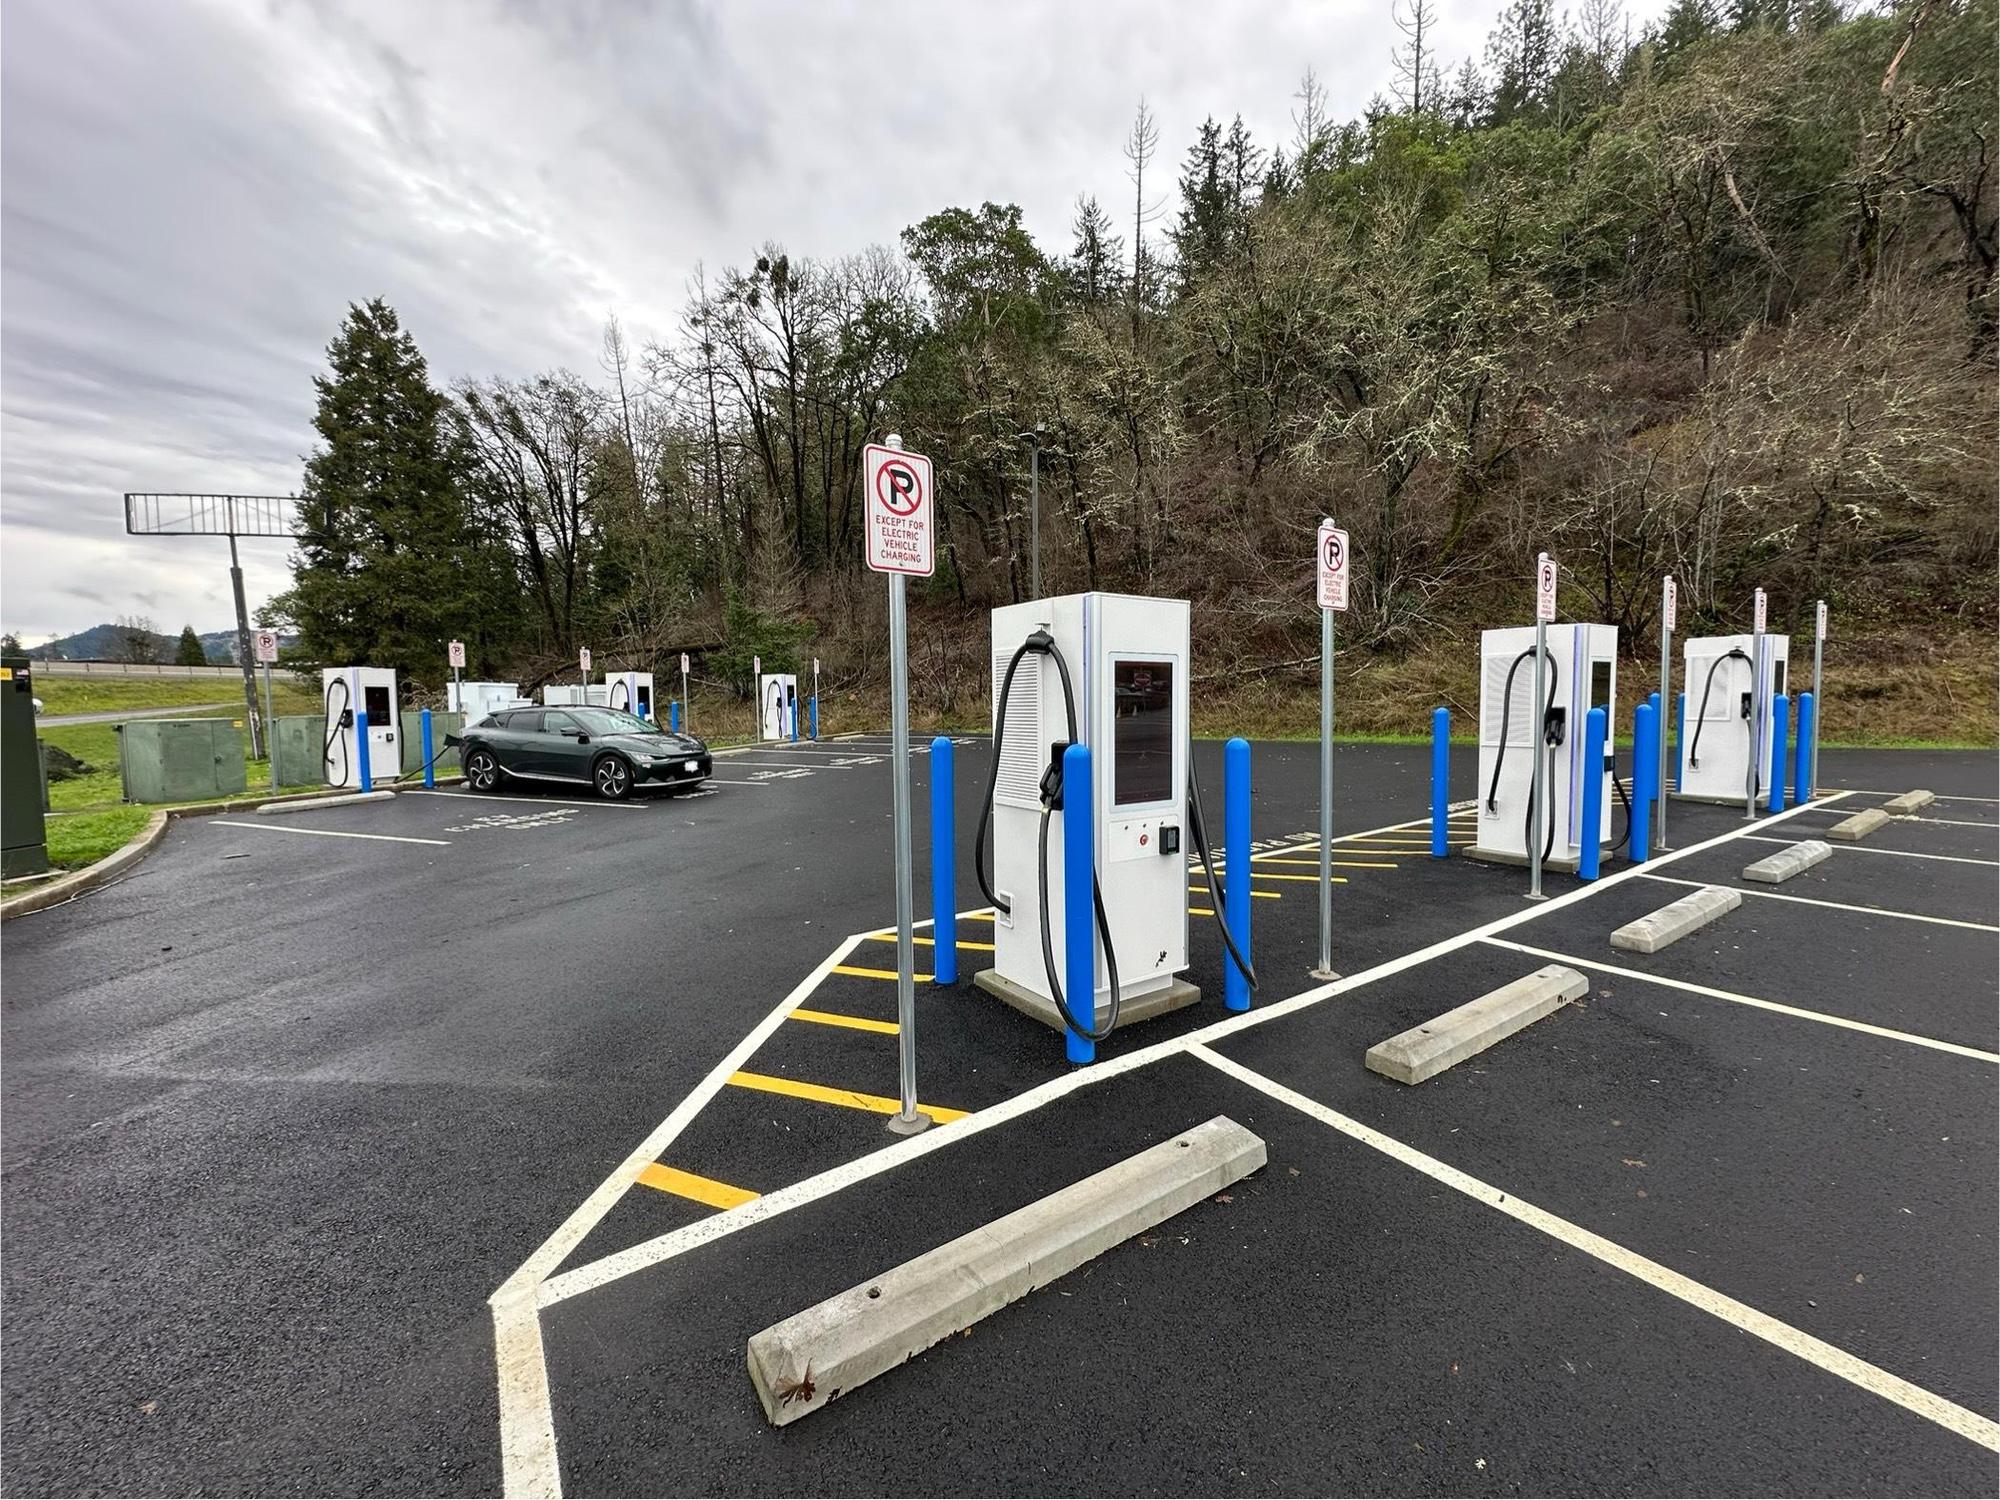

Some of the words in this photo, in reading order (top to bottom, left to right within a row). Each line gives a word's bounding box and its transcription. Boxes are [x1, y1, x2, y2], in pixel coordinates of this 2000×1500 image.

[890, 469, 914, 505] P
[876, 514, 906, 528] EXCEPT
[908, 520, 924, 530] FOR
[882, 527, 919, 541] ELECTRIC
[884, 538, 917, 551] VEHICLE
[880, 549, 922, 564] CHARGING
